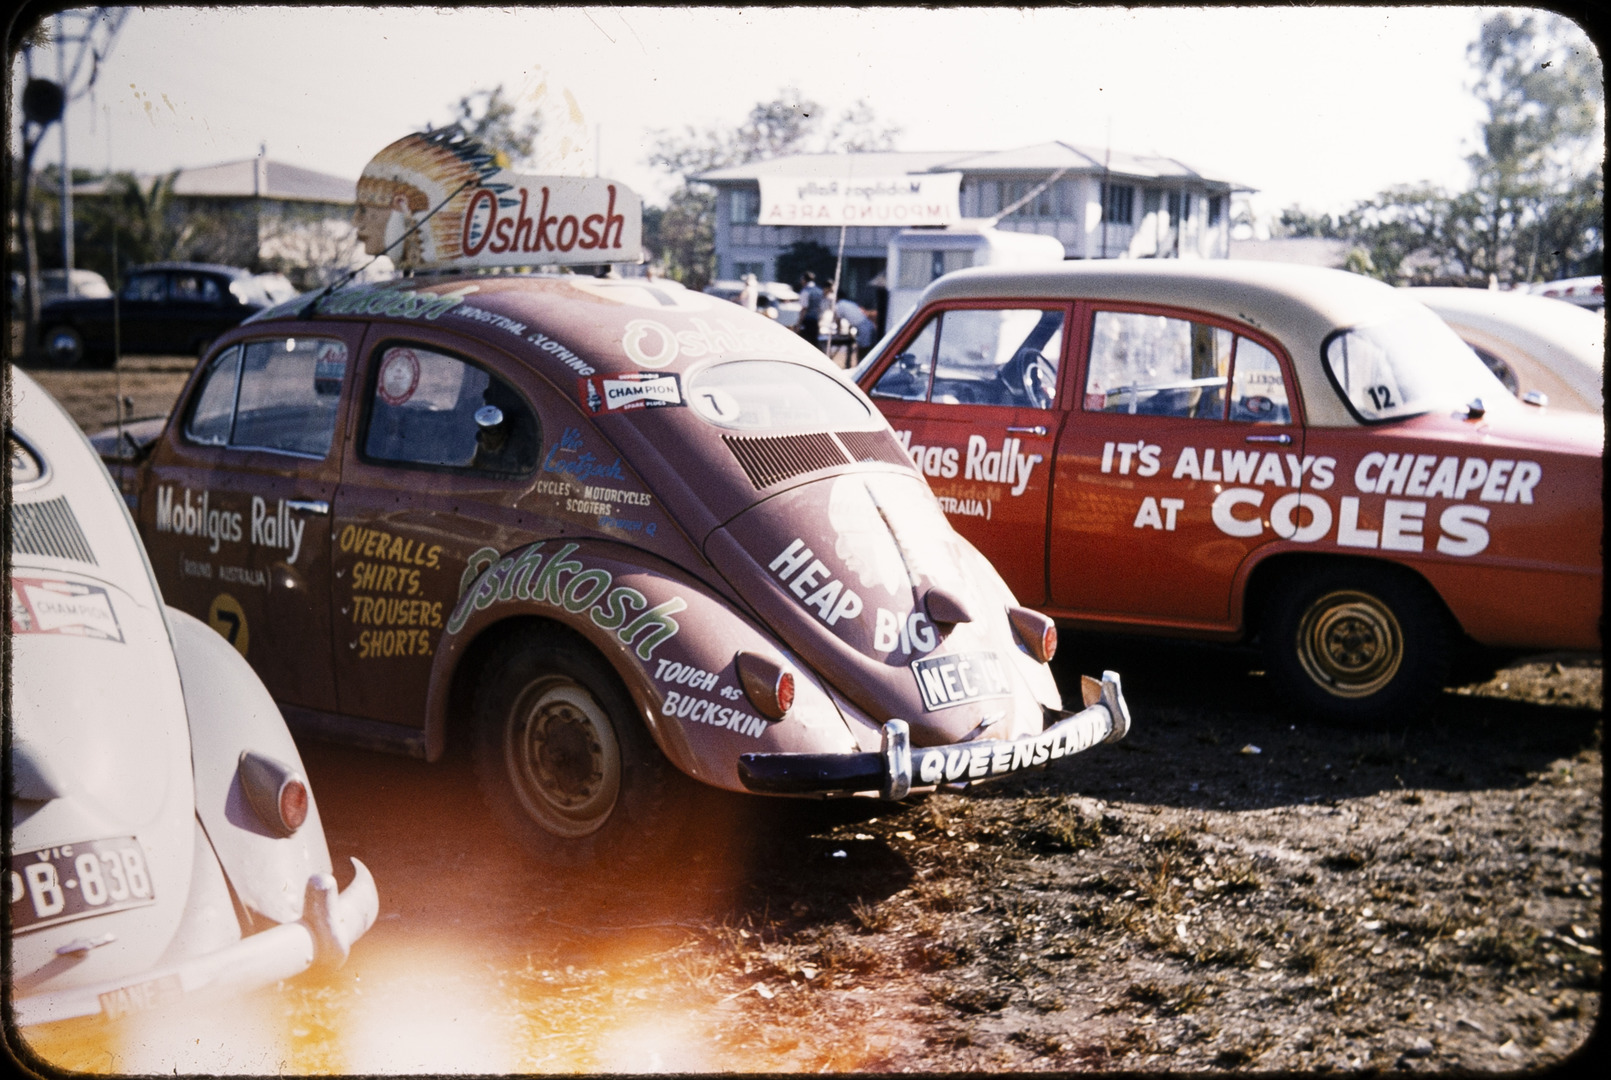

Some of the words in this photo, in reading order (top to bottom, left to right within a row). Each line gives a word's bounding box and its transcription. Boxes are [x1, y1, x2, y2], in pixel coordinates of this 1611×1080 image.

[462, 184, 625, 257] Oshkosh
[527, 333, 596, 376] CLOTHING
[608, 385, 674, 399] CHAMPION
[1367, 385, 1395, 411] 12
[964, 434, 1035, 497] Rally
[1100, 439, 1162, 477] IT'S
[1172, 447, 1337, 490] ALWAYS
[1354, 452, 1543, 504] CHEAPER
[537, 480, 571, 496] CYCLES
[584, 486, 652, 506] MOTORCYCLES
[566, 498, 612, 515] SCOOTERS
[156, 485, 243, 553] Mobilgas
[251, 495, 306, 564] Rally
[1133, 497, 1184, 531] AT
[1211, 487, 1491, 556] COLES
[37, 601, 110, 620] CHAMPION
[447, 542, 688, 661] Oshkosh
[768, 537, 864, 627] HEAP
[873, 607, 938, 655] BIG
[217, 609, 240, 645] 7
[654, 658, 719, 692] TOUGH
[720, 685, 744, 701] AS
[661, 691, 768, 739] BUCKSKIN
[36, 845, 74, 862] VIC
